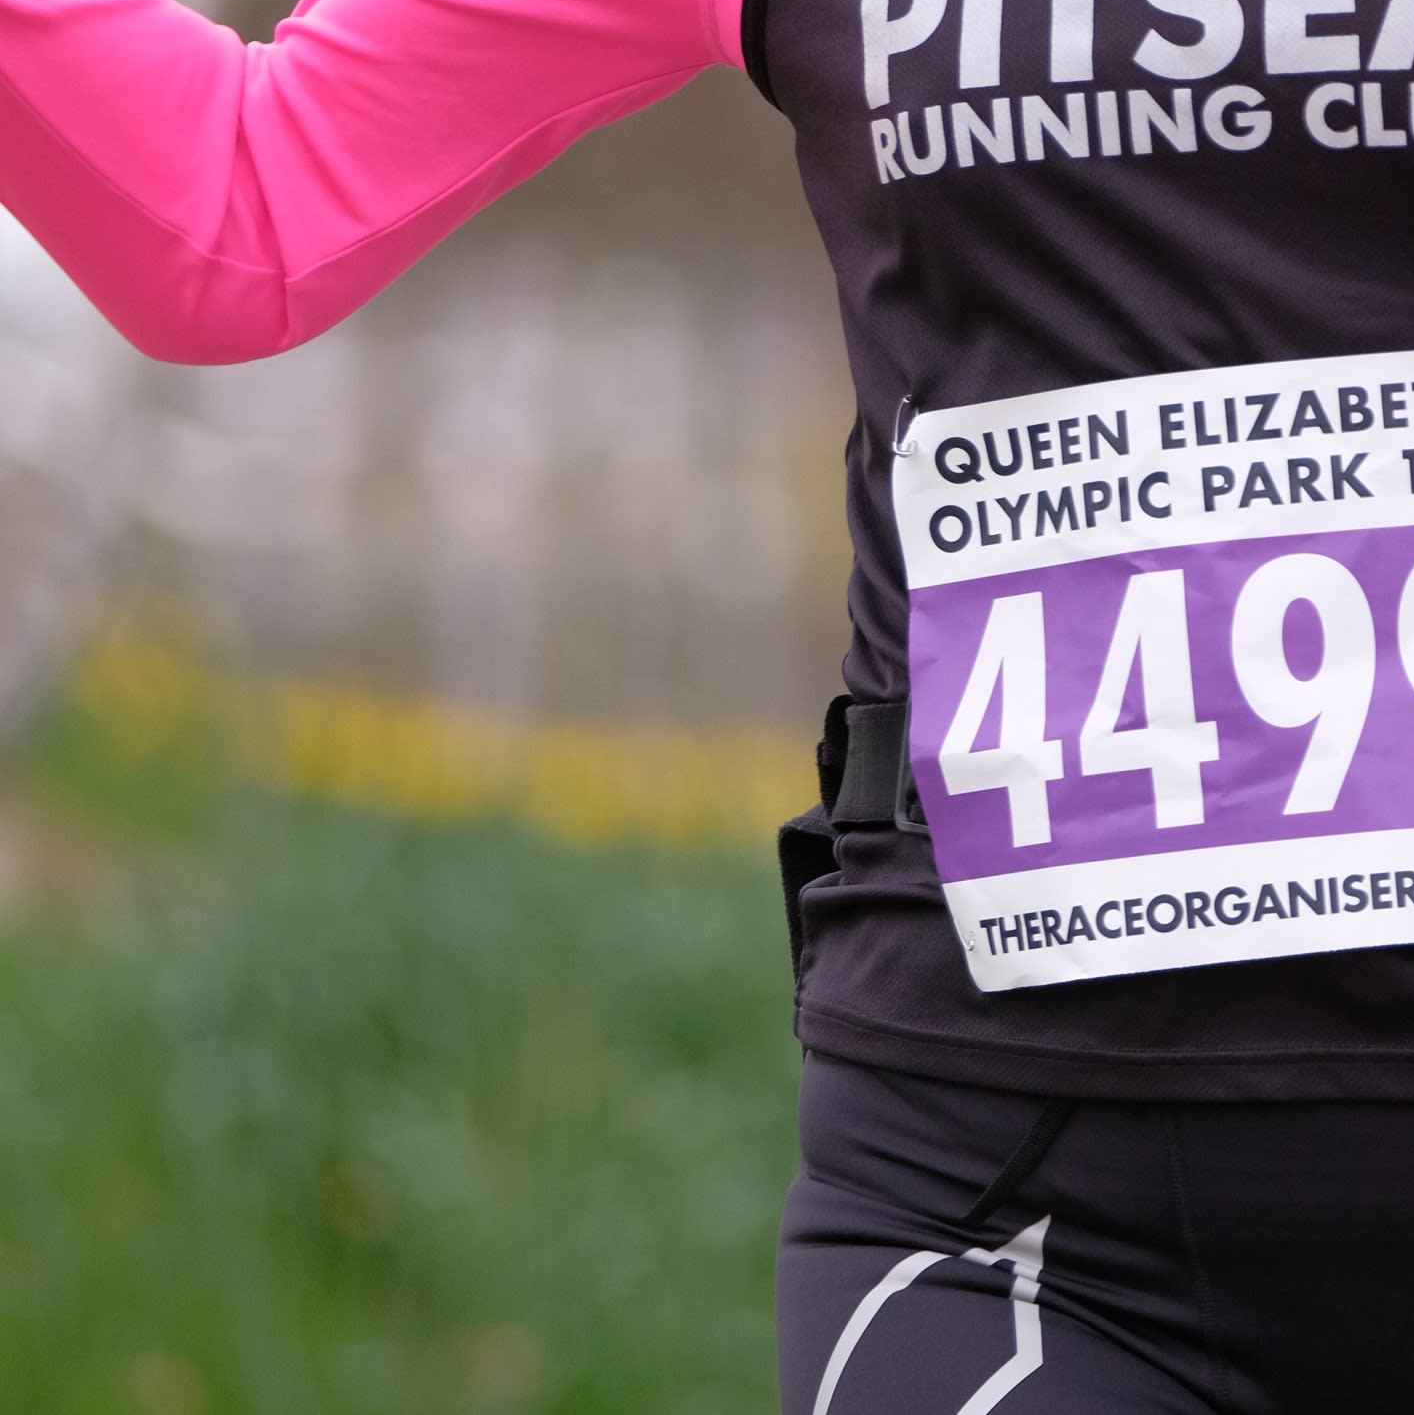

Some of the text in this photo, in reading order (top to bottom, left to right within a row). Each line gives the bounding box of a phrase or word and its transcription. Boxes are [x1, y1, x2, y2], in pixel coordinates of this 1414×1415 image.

[869, 84, 1273, 185] RUNNING
[933, 409, 1130, 485] QUEEN
[928, 471, 1174, 554] OLYMPIC
[1202, 452, 1374, 513] PARK
